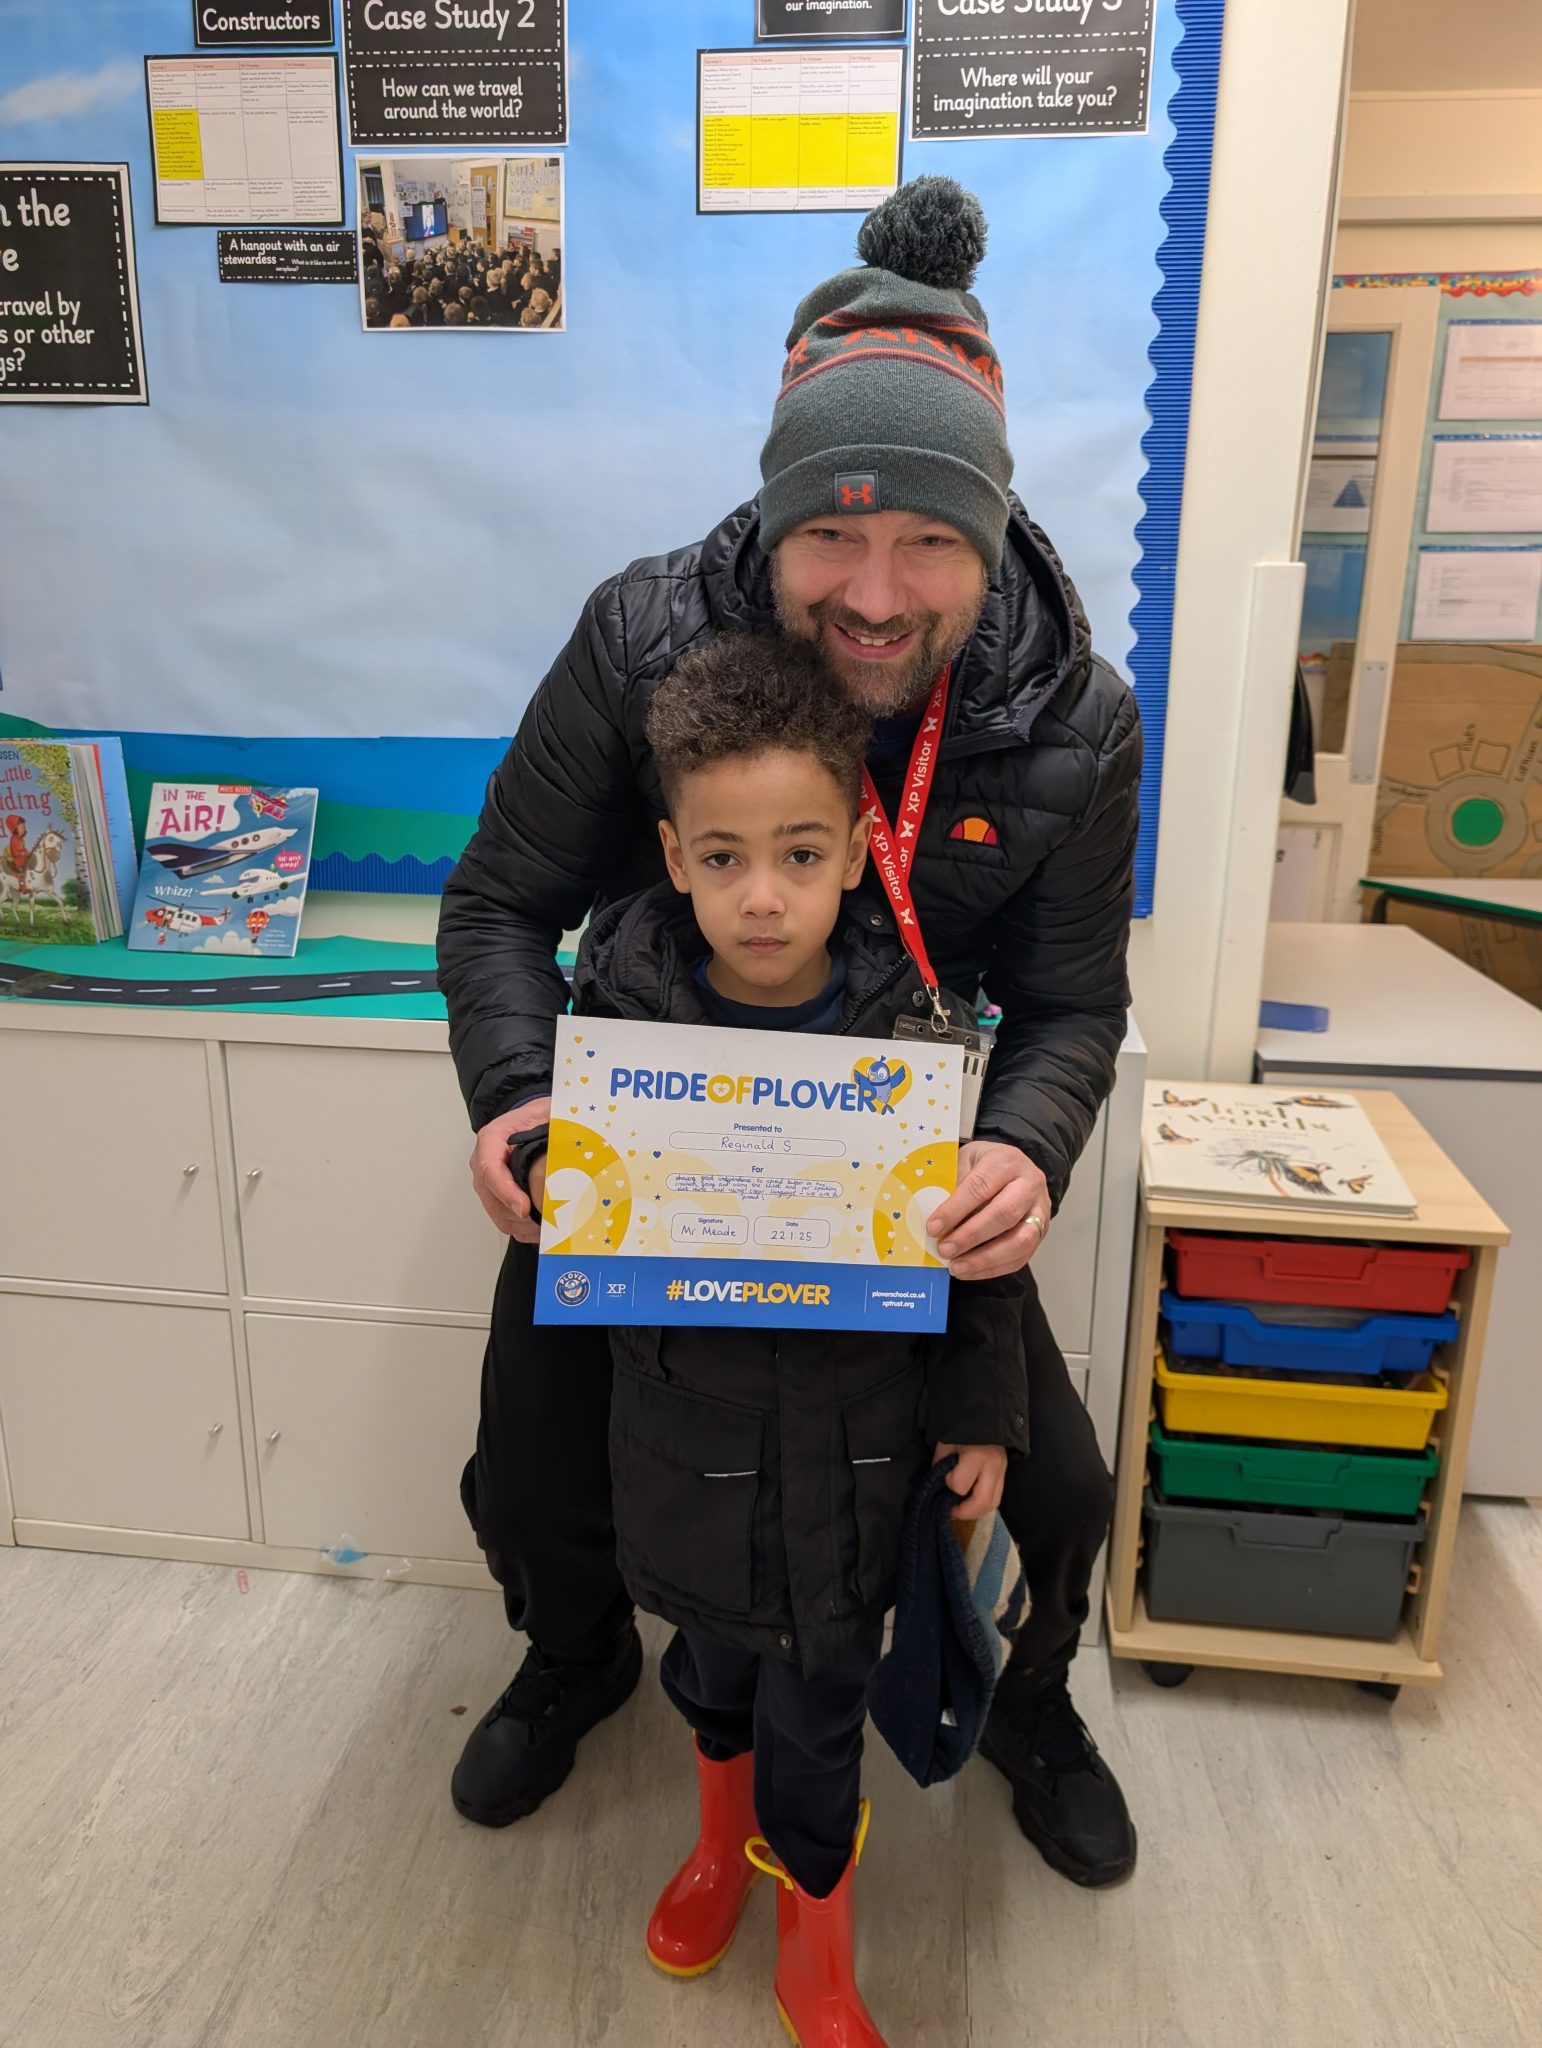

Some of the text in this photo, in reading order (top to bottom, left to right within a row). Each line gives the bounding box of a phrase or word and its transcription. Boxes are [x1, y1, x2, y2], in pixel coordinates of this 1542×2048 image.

[785, 1, 804, 12] our
[203, 8, 320, 31] Constructors
[364, 0, 536, 41] Case Study 2
[382, 76, 524, 98] How can we travel
[961, 65, 1094, 92] Where will your
[384, 98, 523, 120] around the world?
[933, 85, 1118, 118] imagination take you?
[17, 187, 71, 227] the
[229, 238, 340, 255] A hangout with an air
[223, 253, 277, 265] stewardess
[57, 290, 81, 326] by
[14, 328, 35, 344] or
[41, 319, 95, 344] other
[907, 740, 932, 813] XP Visitor
[186, 790, 207, 801] THE
[873, 831, 904, 901] XP Visitor
[154, 885, 194, 898] Whizz!
[733, 1123, 783, 1133] Presented to
[721, 1136, 774, 1152] Reginald
[681, 1225, 737, 1237] Mr Meade
[698, 1217, 724, 1225] Signature
[559, 1272, 587, 1285] PLOVER
[666, 1280, 831, 1305] #LOVEPLOVER
